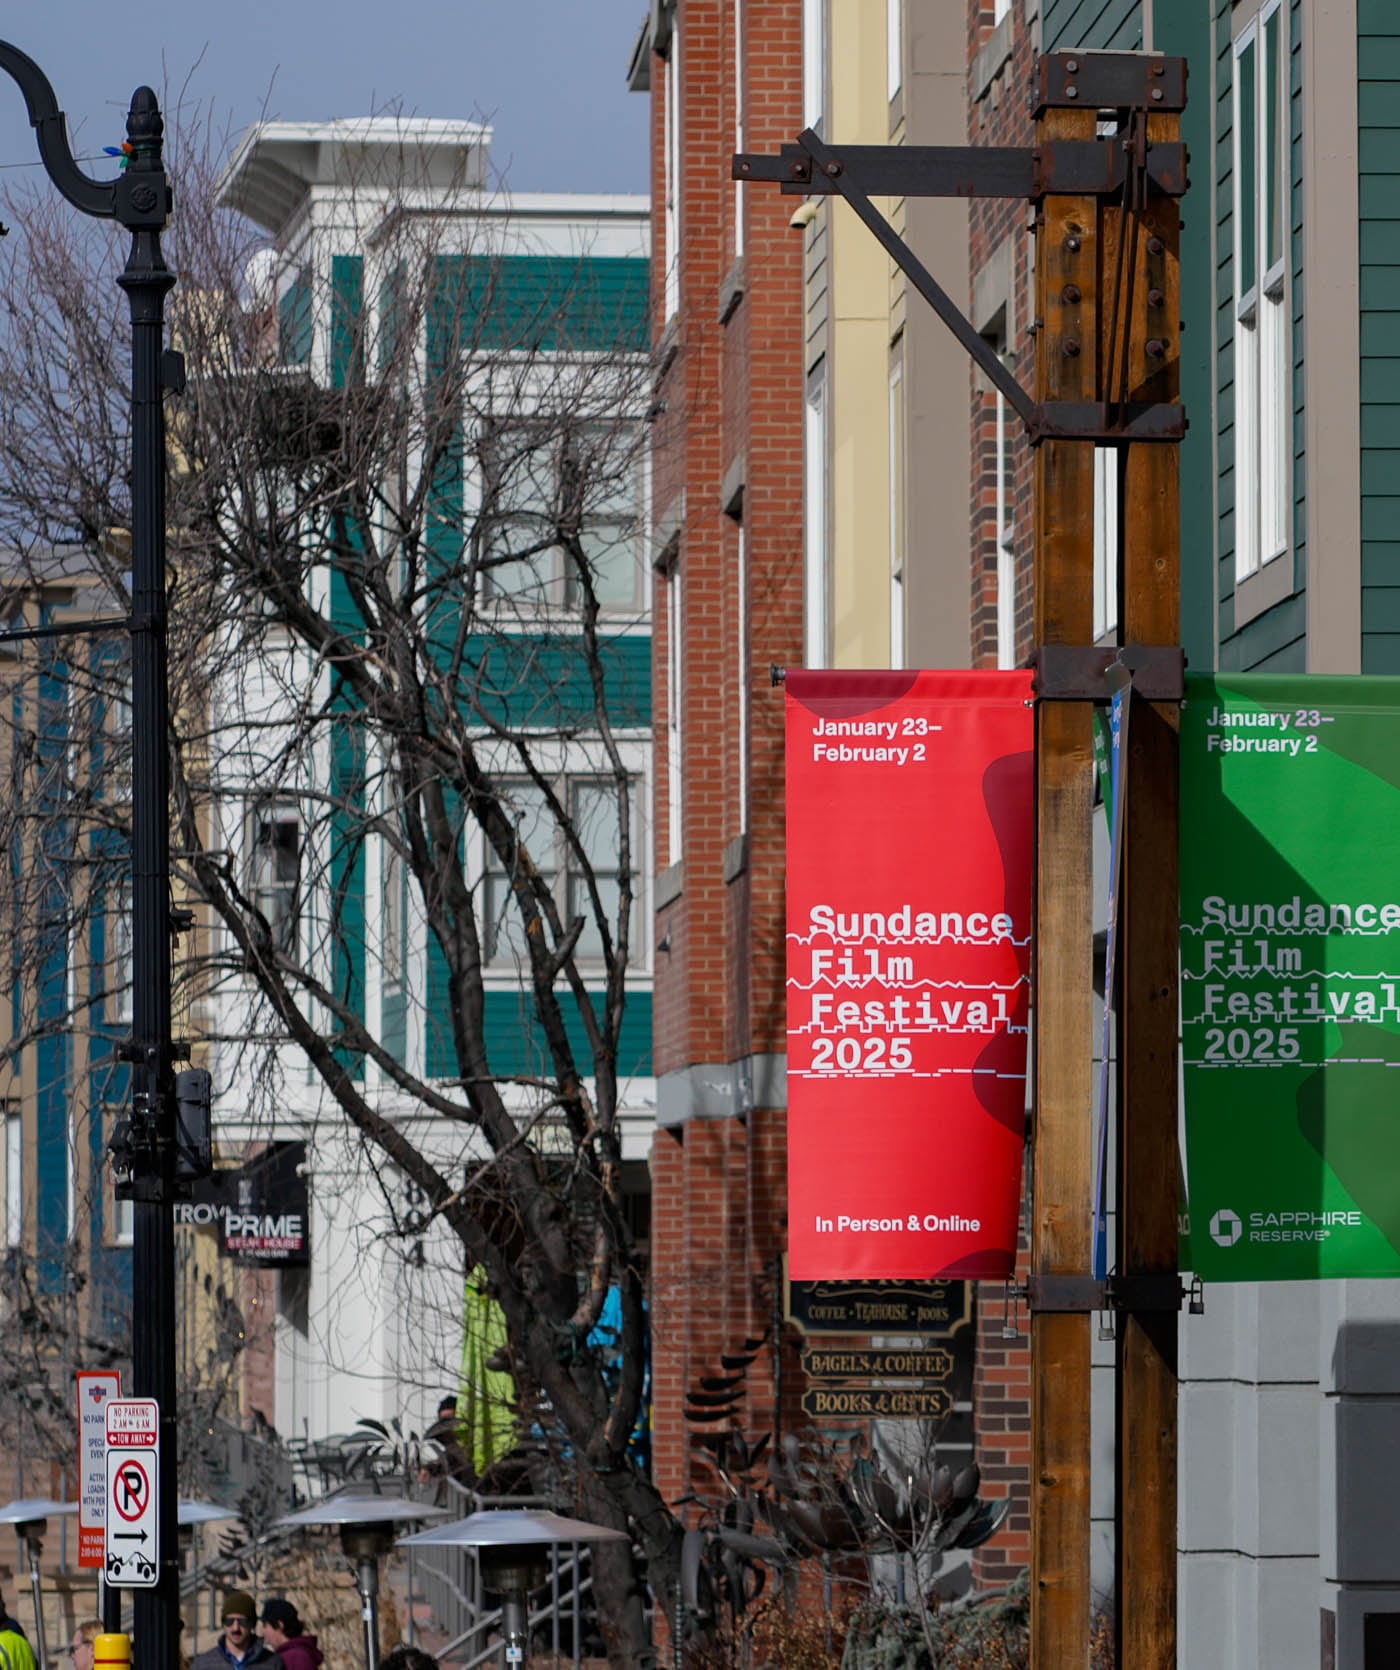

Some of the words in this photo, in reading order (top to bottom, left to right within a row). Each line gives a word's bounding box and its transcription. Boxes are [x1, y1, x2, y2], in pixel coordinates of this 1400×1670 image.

[812, 718, 898, 740] January
[1206, 706, 1290, 730] January
[813, 743, 909, 765] February
[913, 744, 926, 762] 2
[1207, 734, 1301, 756] February
[1305, 735, 1318, 752] 2
[809, 904, 1013, 937] Sundance
[812, 948, 914, 981] Film
[1204, 939, 1302, 972] Film
[811, 992, 1008, 1025] Festival
[1204, 982, 1396, 1015] Festival
[810, 1037, 913, 1070] 2025
[1204, 1028, 1299, 1060] 2025
[225, 1214, 302, 1238] PRIME
[815, 1216, 833, 1232] In
[837, 1216, 903, 1232] Person
[907, 1215, 921, 1231] &
[923, 1215, 981, 1232] Online
[1249, 1211, 1362, 1227] SAPPHIRE
[811, 1355, 870, 1373] BAGELS
[885, 1354, 945, 1372] COFFEE
[114, 1407, 122, 1417] NO
[125, 1407, 149, 1417] PARKING
[816, 1391, 871, 1412] BOOKS
[875, 1393, 889, 1411] &
[891, 1393, 941, 1412] GIFTS
[83, 1415, 91, 1424] NO
[113, 1419, 118, 1429] 2
[119, 1419, 128, 1429] AM
[141, 1419, 150, 1429] AM
[117, 1433, 129, 1444] TOW
[131, 1433, 146, 1444] AWAY
